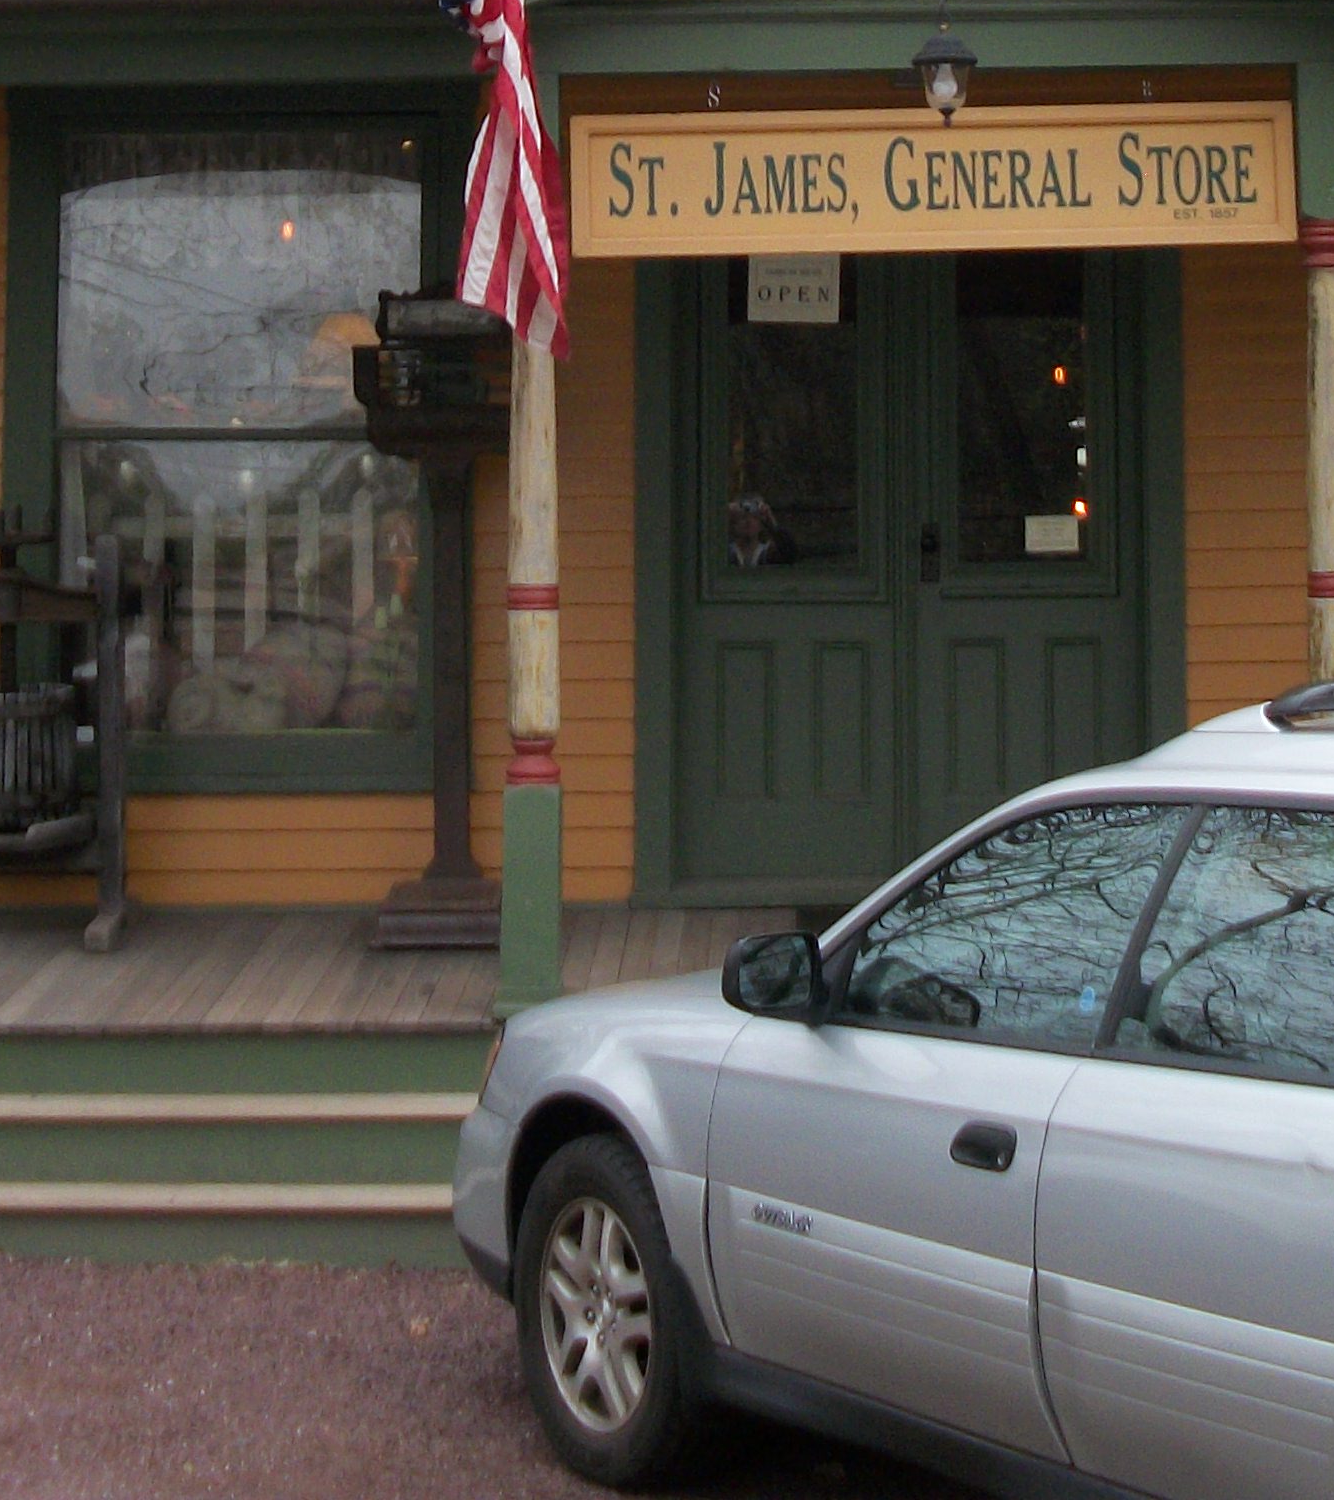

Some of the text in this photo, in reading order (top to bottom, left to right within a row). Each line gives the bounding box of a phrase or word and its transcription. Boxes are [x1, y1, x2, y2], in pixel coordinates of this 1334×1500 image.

[704, 141, 859, 224] JAMES,
[884, 135, 1092, 211] GENERAL
[1118, 131, 1258, 207] STORE
[758, 285, 830, 302] OPEN
